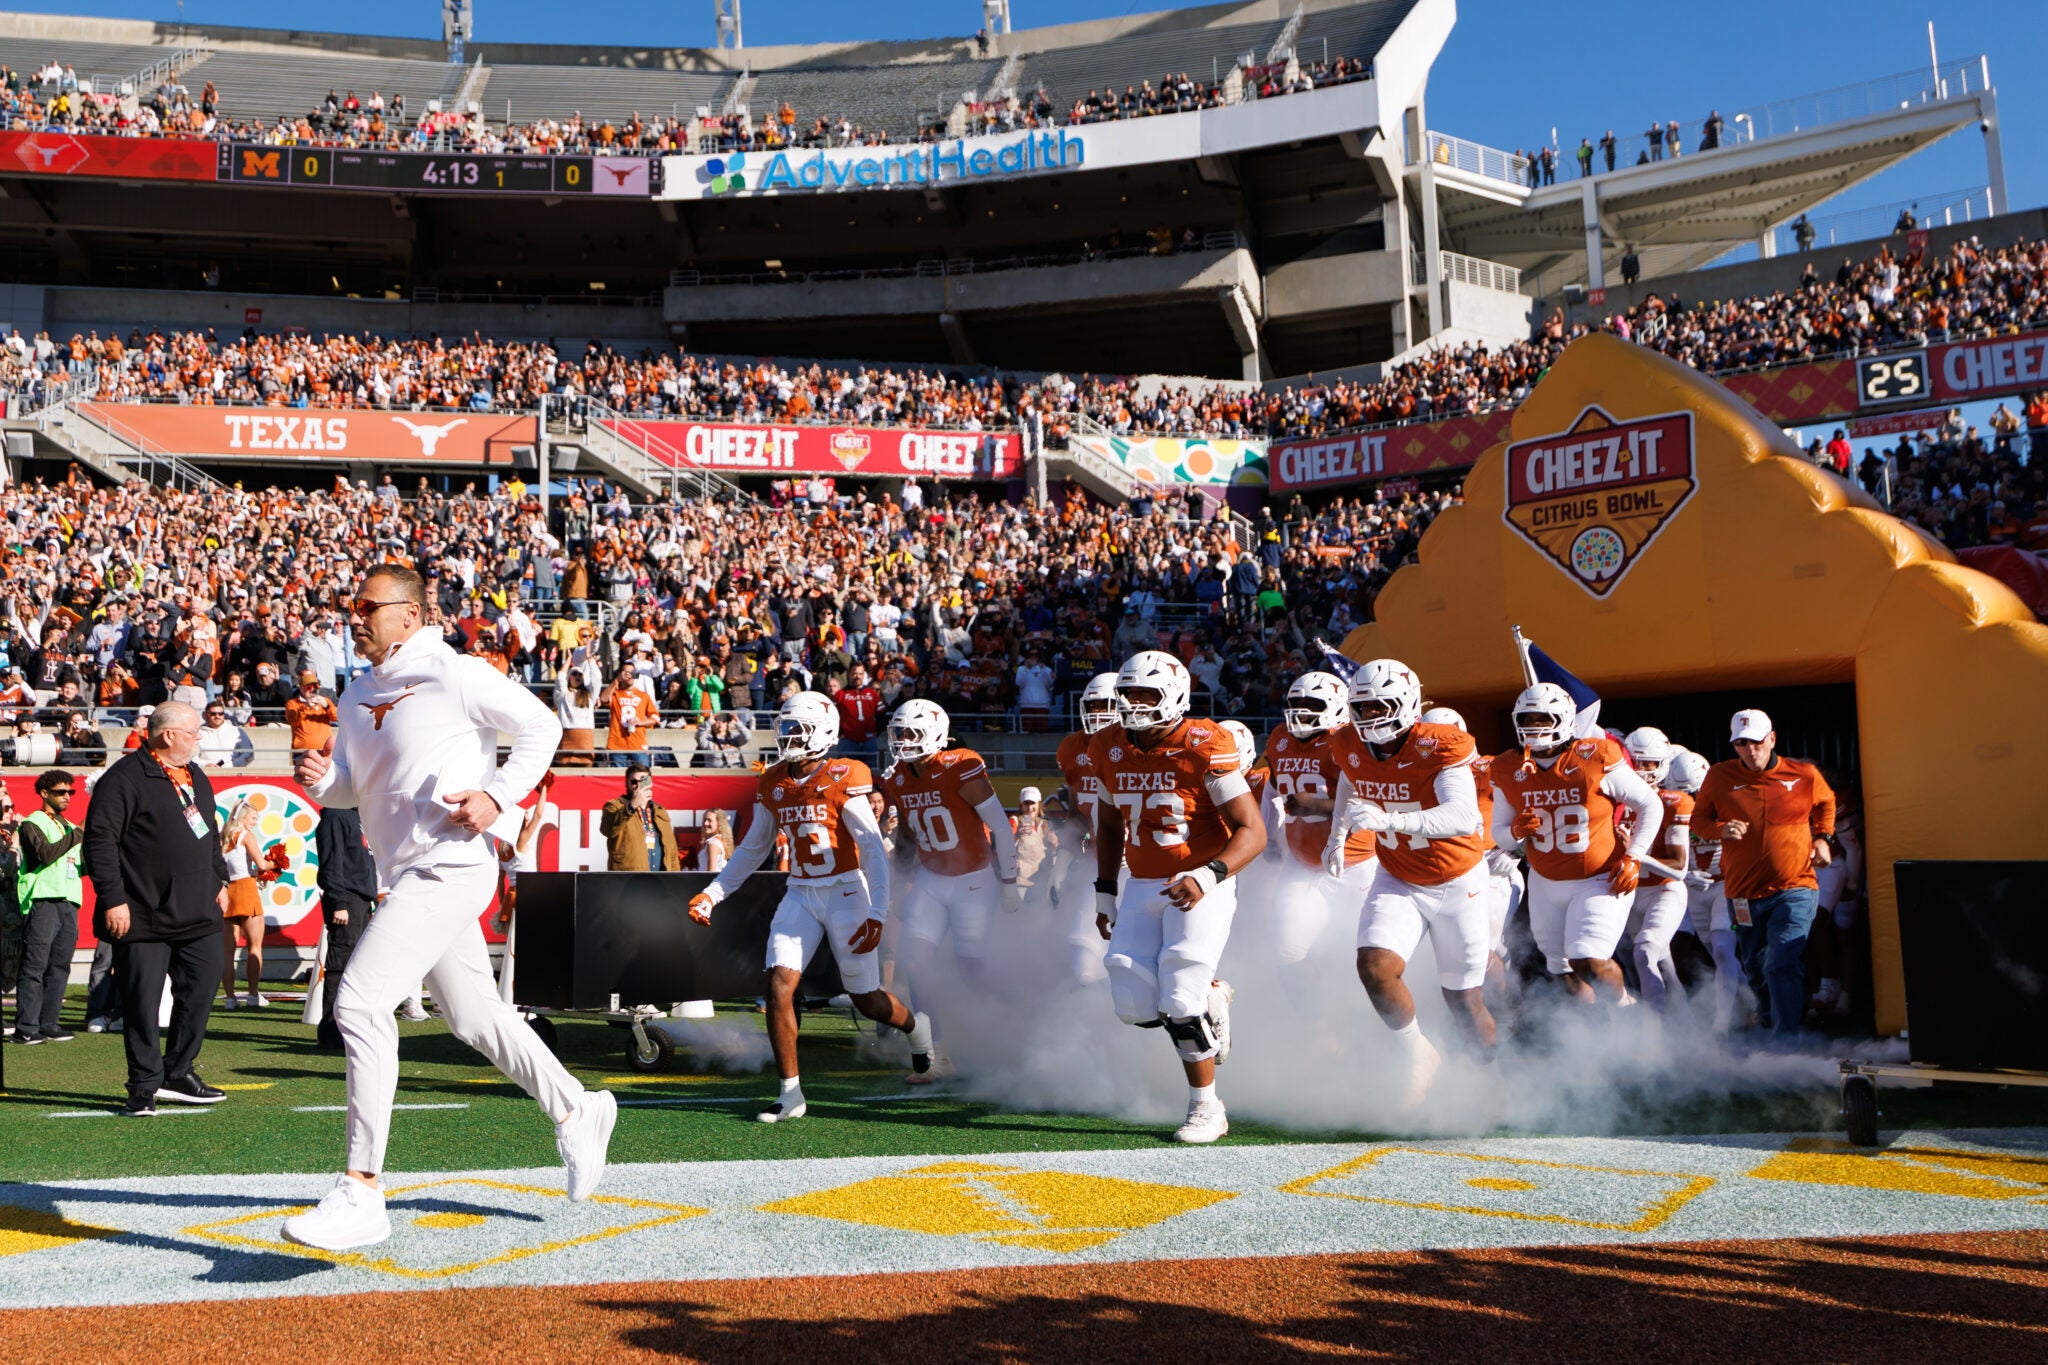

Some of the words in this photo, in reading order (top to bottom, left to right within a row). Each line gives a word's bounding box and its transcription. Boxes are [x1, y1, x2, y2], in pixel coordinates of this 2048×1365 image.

[304, 156, 318, 177] 0
[761, 128, 1085, 188] AdventHealth
[422, 160, 479, 185] 4:13
[495, 170, 504, 188] 1
[566, 164, 580, 185] 0
[1867, 358, 1920, 399] 25
[224, 414, 348, 451] TEXAS
[1532, 498, 1598, 526] CITRUS
[1606, 489, 1664, 515] BOWL
[1071, 660, 1095, 669] HAIL
[856, 700, 865, 721] 1
[1276, 758, 1320, 774] TEXAS
[1115, 771, 1175, 791] TEXAS
[1355, 779, 1410, 801] TEXAS
[901, 790, 942, 809] TEXAS
[1522, 787, 1581, 807] TEXAS
[778, 803, 829, 823] TEXAS
[1077, 792, 1099, 838] 7
[1112, 792, 1190, 847] 73
[908, 805, 959, 852] 10
[1526, 803, 1590, 854] 98
[783, 823, 837, 877] 13
